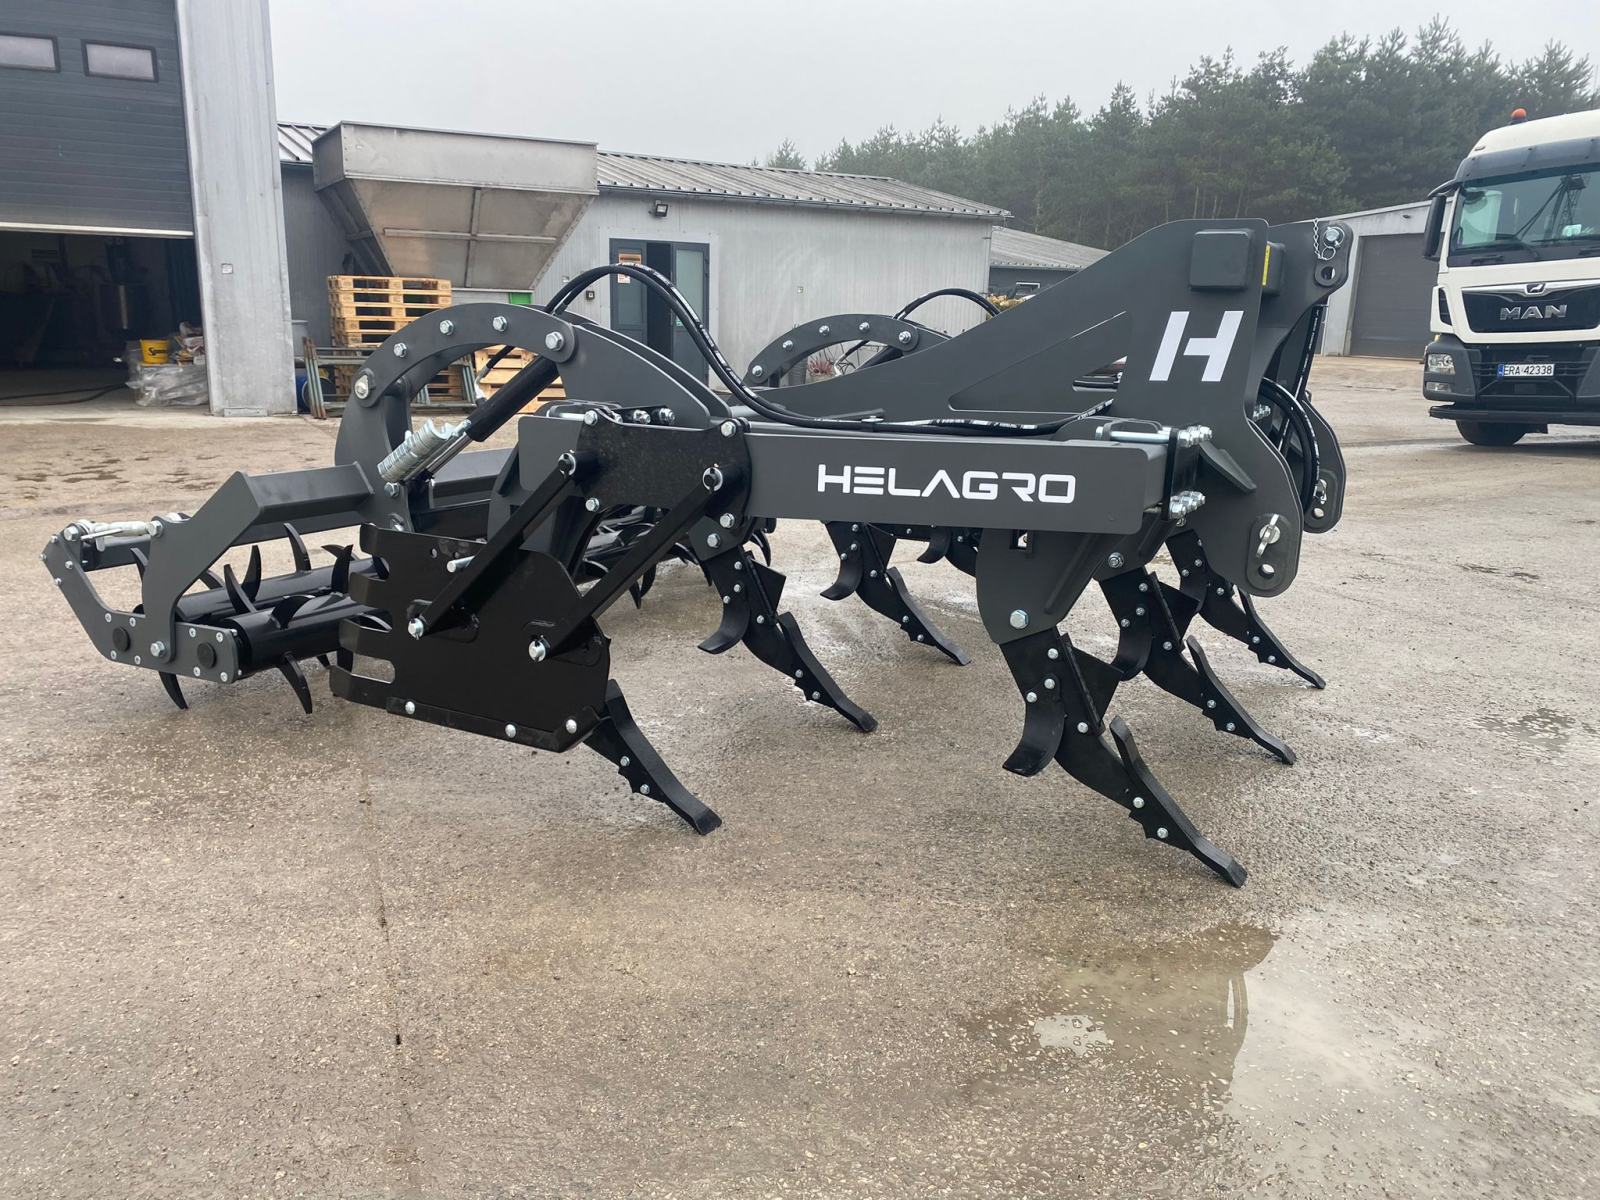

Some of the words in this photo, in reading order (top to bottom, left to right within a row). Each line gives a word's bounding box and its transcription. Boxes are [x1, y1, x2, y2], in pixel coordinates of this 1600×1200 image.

[1500, 304, 1568, 321] MAN
[1504, 365, 1520, 376] ERA
[1523, 365, 1553, 375] 42338
[817, 463, 1076, 504] HELAGRO
